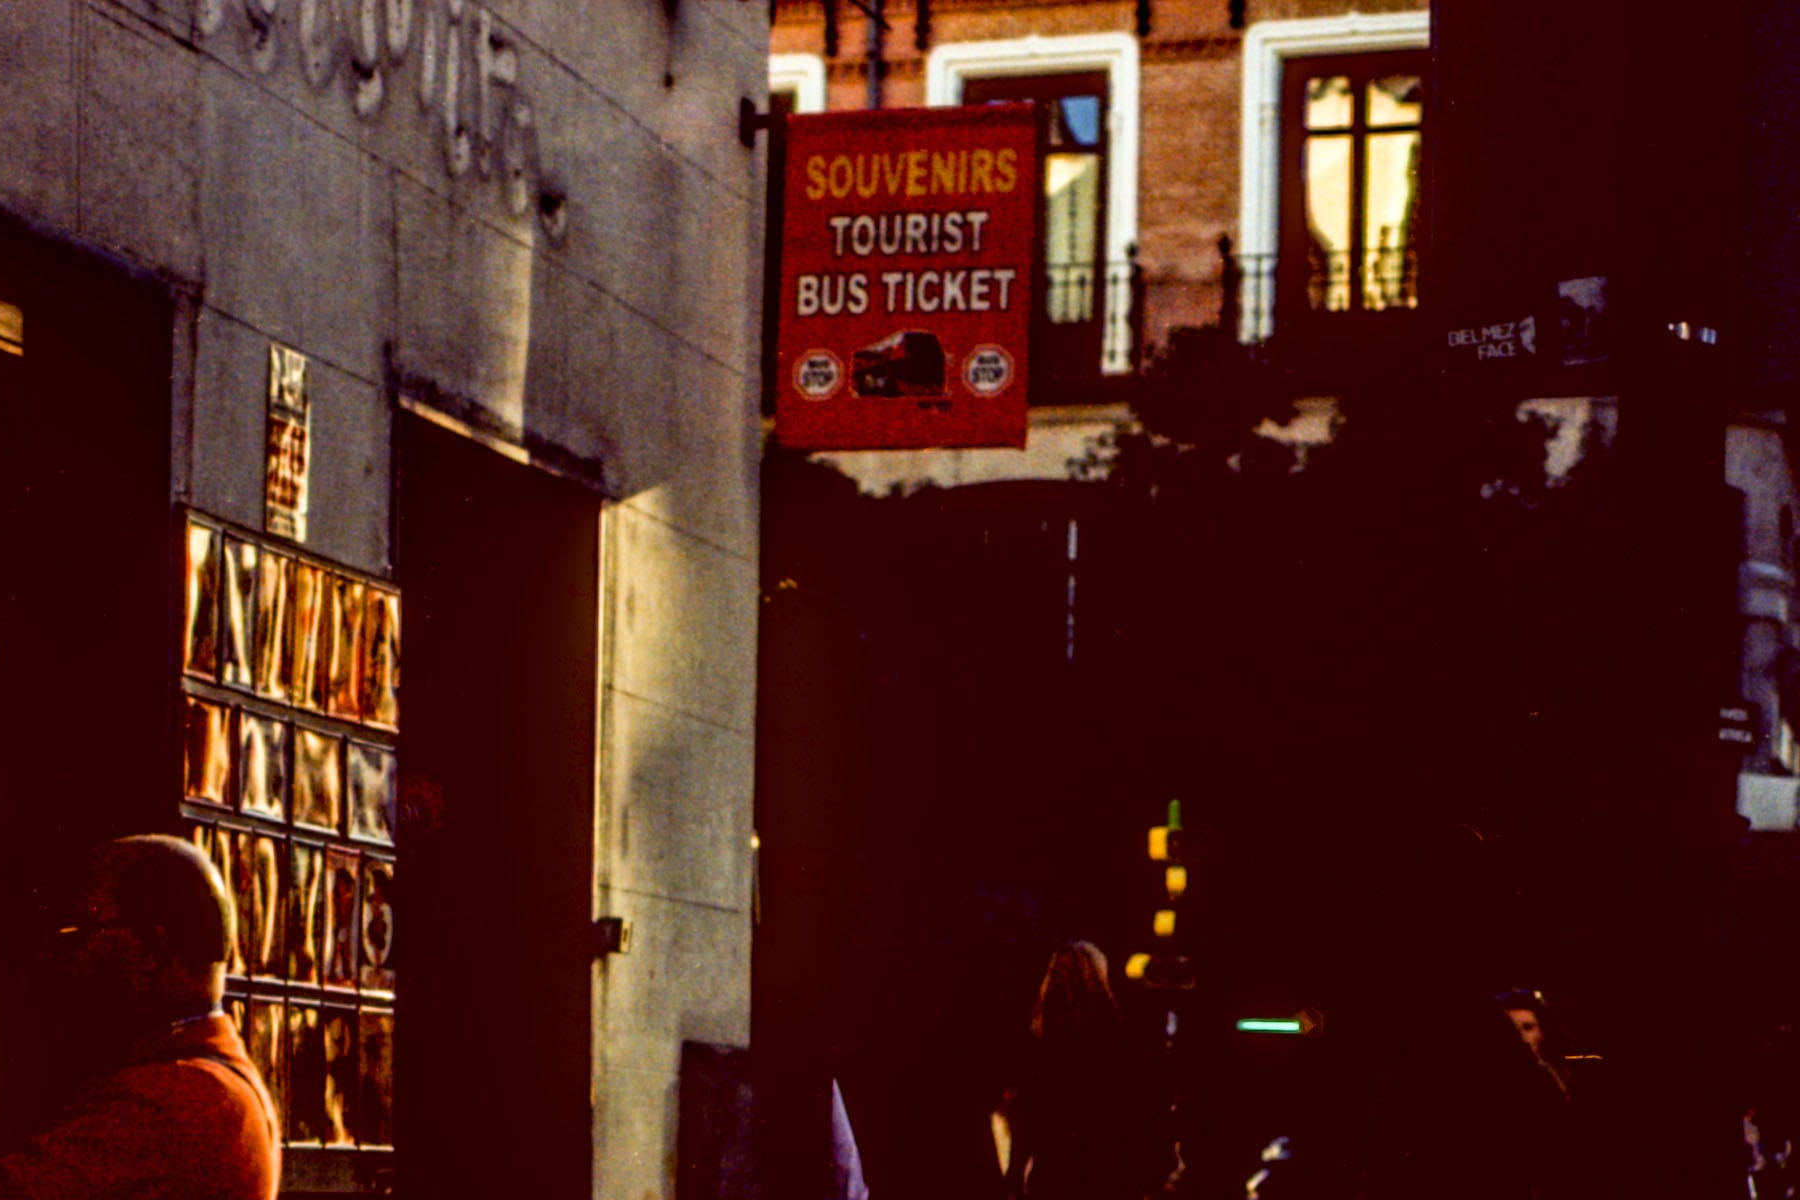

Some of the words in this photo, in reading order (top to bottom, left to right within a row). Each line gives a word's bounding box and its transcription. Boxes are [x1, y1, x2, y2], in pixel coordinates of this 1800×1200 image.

[806, 149, 1017, 199] SOUVENIRS
[830, 211, 989, 256] TOURIST
[797, 273, 869, 315] BUS
[881, 269, 1015, 312] TICKET
